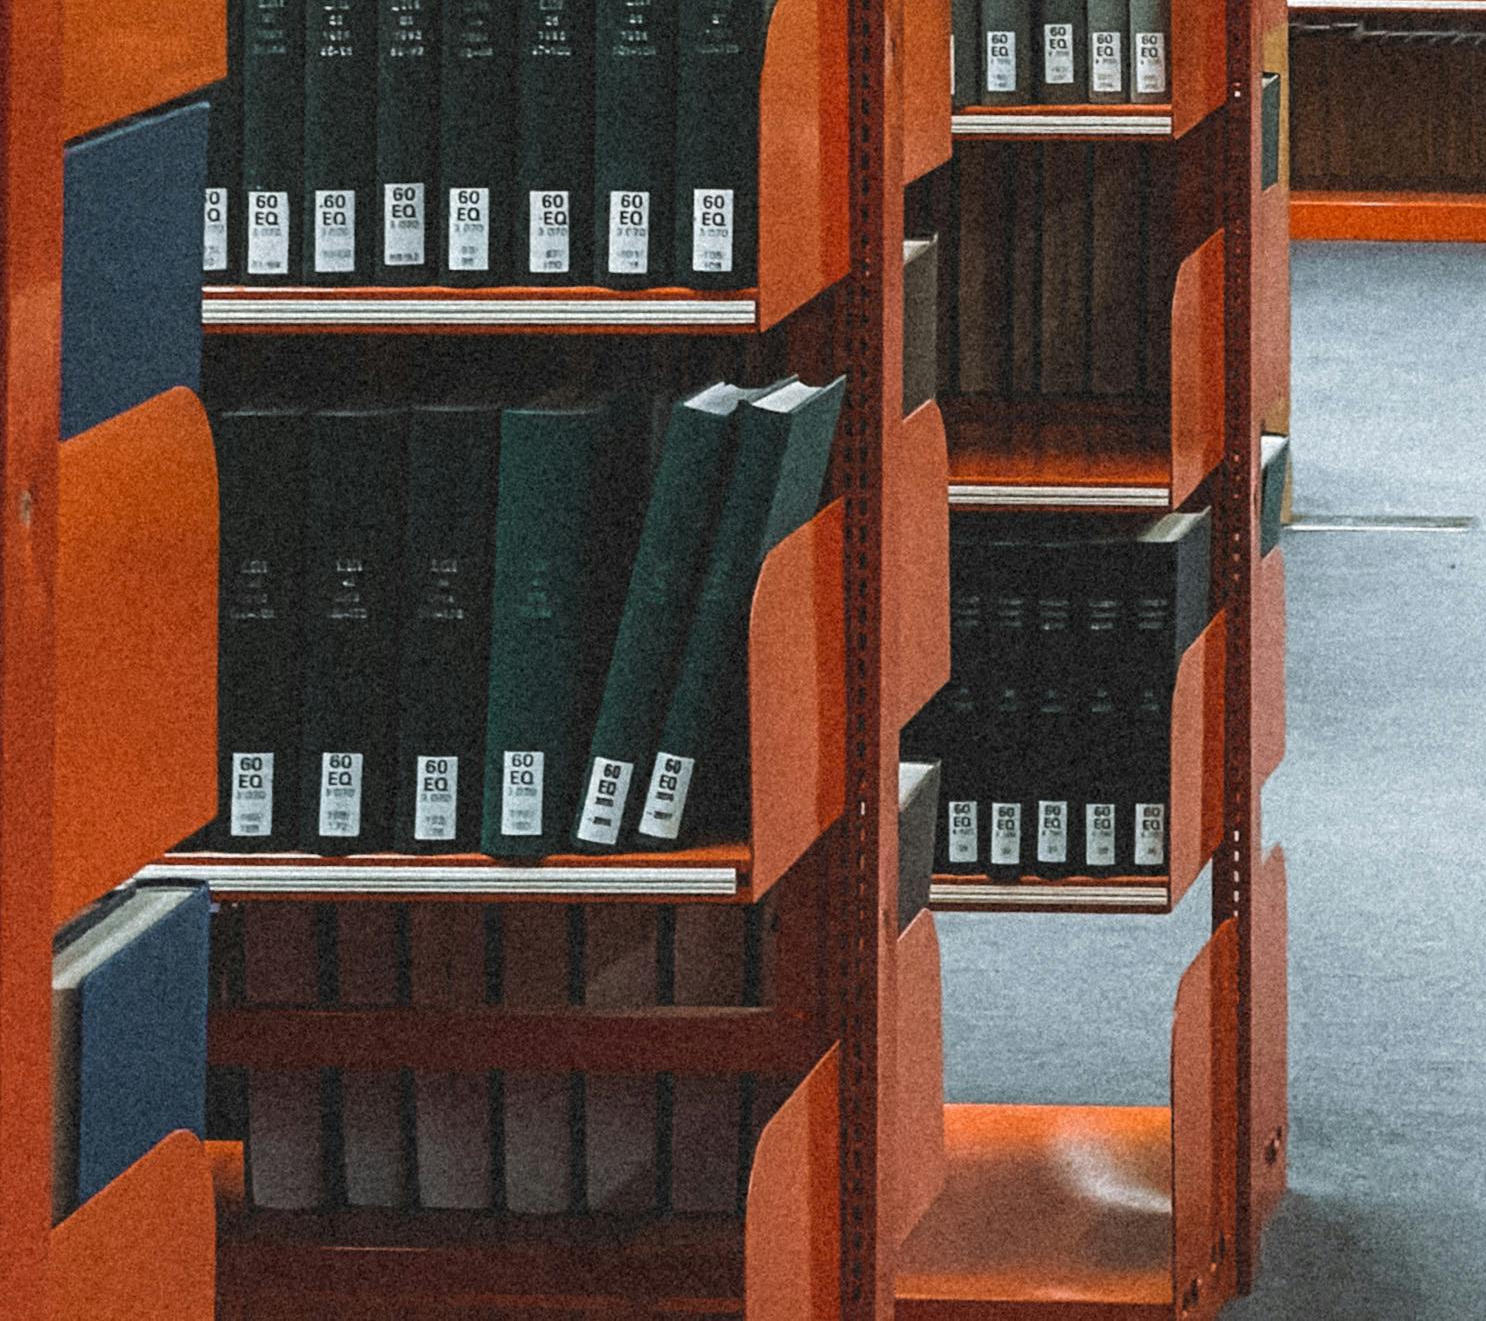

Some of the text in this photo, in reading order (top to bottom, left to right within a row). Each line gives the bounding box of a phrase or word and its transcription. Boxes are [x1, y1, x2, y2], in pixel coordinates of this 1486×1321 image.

[1050, 39, 1067, 49] EQ
[991, 47, 1008, 57] EQ
[1096, 47, 1114, 57] EQ
[1141, 47, 1158, 57] EQ
[393, 187, 415, 201] 60
[458, 191, 480, 204] 60
[256, 195, 278, 208] 60
[324, 195, 346, 208] 60
[542, 195, 563, 208] 60
[621, 195, 643, 208] 60
[703, 195, 725, 208] 60
[392, 204, 416, 218] EQ
[457, 208, 480, 221] EQ
[255, 212, 279, 225] EQ
[322, 212, 346, 225] EQ
[543, 213, 567, 226] EQ
[619, 211, 643, 225] EQ
[702, 212, 726, 226] EQ
[240, 757, 263, 770] 60
[329, 755, 352, 769] 60
[425, 760, 448, 773] 60
[512, 754, 534, 767] 60
[665, 758, 682, 774] 60
[603, 763, 621, 779] 60
[238, 774, 263, 788] EQ
[328, 772, 353, 786] EQ
[424, 777, 448, 791] EQ
[510, 771, 534, 785] EQ
[659, 775, 677, 790] EQ
[953, 817, 971, 827] EQ
[997, 820, 1015, 830] EQ
[1043, 818, 1061, 829] EQ
[1094, 819, 1111, 830] EQ
[1142, 820, 1160, 831] EQ
